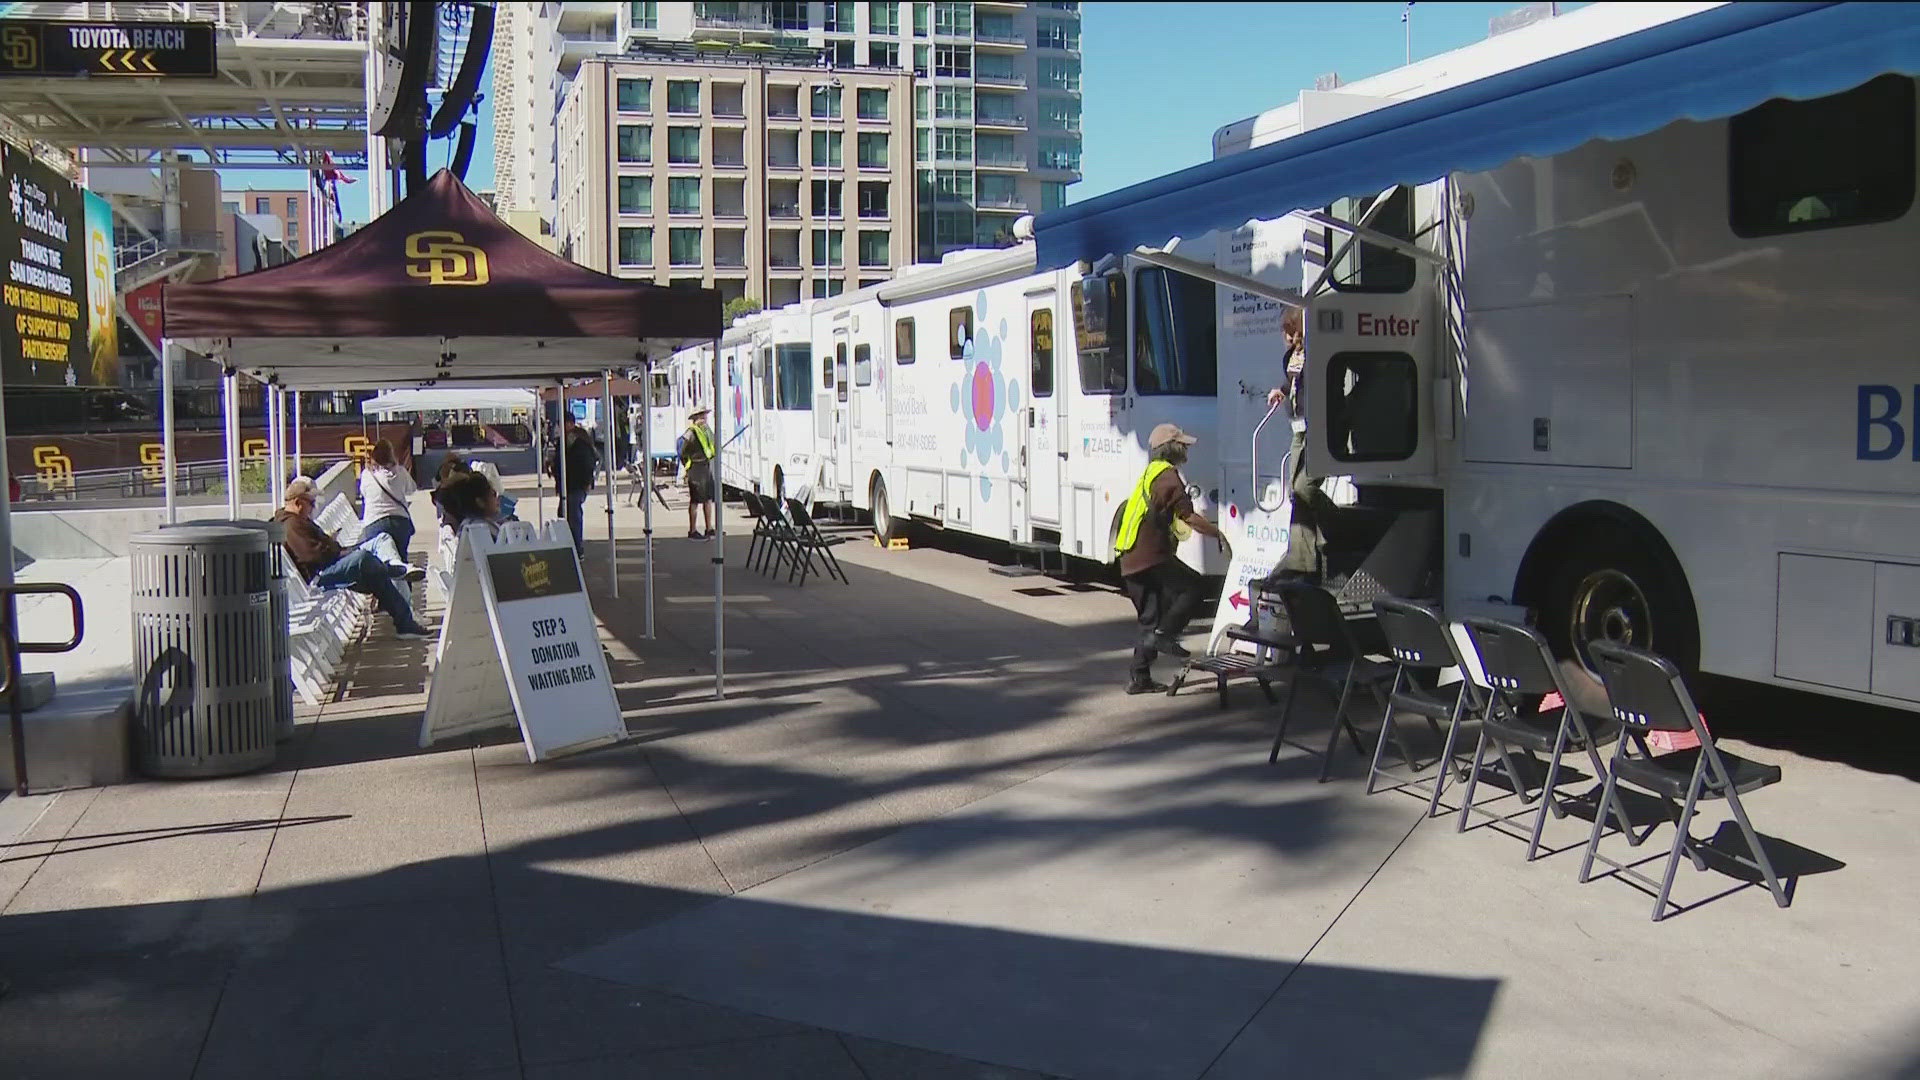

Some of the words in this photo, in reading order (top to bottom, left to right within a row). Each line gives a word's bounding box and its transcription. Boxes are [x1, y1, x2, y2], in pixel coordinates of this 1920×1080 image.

[69, 28, 130, 49] TOYOTA
[133, 29, 186, 49] BEACH
[24, 199, 48, 235] Blood
[48, 210, 69, 243] Bank
[20, 238, 48, 265] THANKS
[48, 249, 62, 270] THE
[10, 260, 26, 283] SAN
[26, 265, 47, 290] DIEGO
[47, 272, 72, 296] PADRES
[4, 284, 20, 307] FOR
[20, 288, 41, 312] THEIR
[41, 294, 60, 315] MANY
[60, 300, 79, 320] YEARS
[16, 313, 27, 334] OF
[27, 316, 57, 338] SUPPORT
[57, 321, 71, 340] AND
[1358, 312, 1419, 336] Enter
[911, 394, 928, 415] Bank
[1091, 438, 1122, 454] ZABLE
[532, 618, 557, 638] STEP
[558, 617, 567, 634] 3
[531, 641, 580, 664] DONATION
[527, 668, 571, 691] WAITING
[570, 664, 596, 683] AREA
